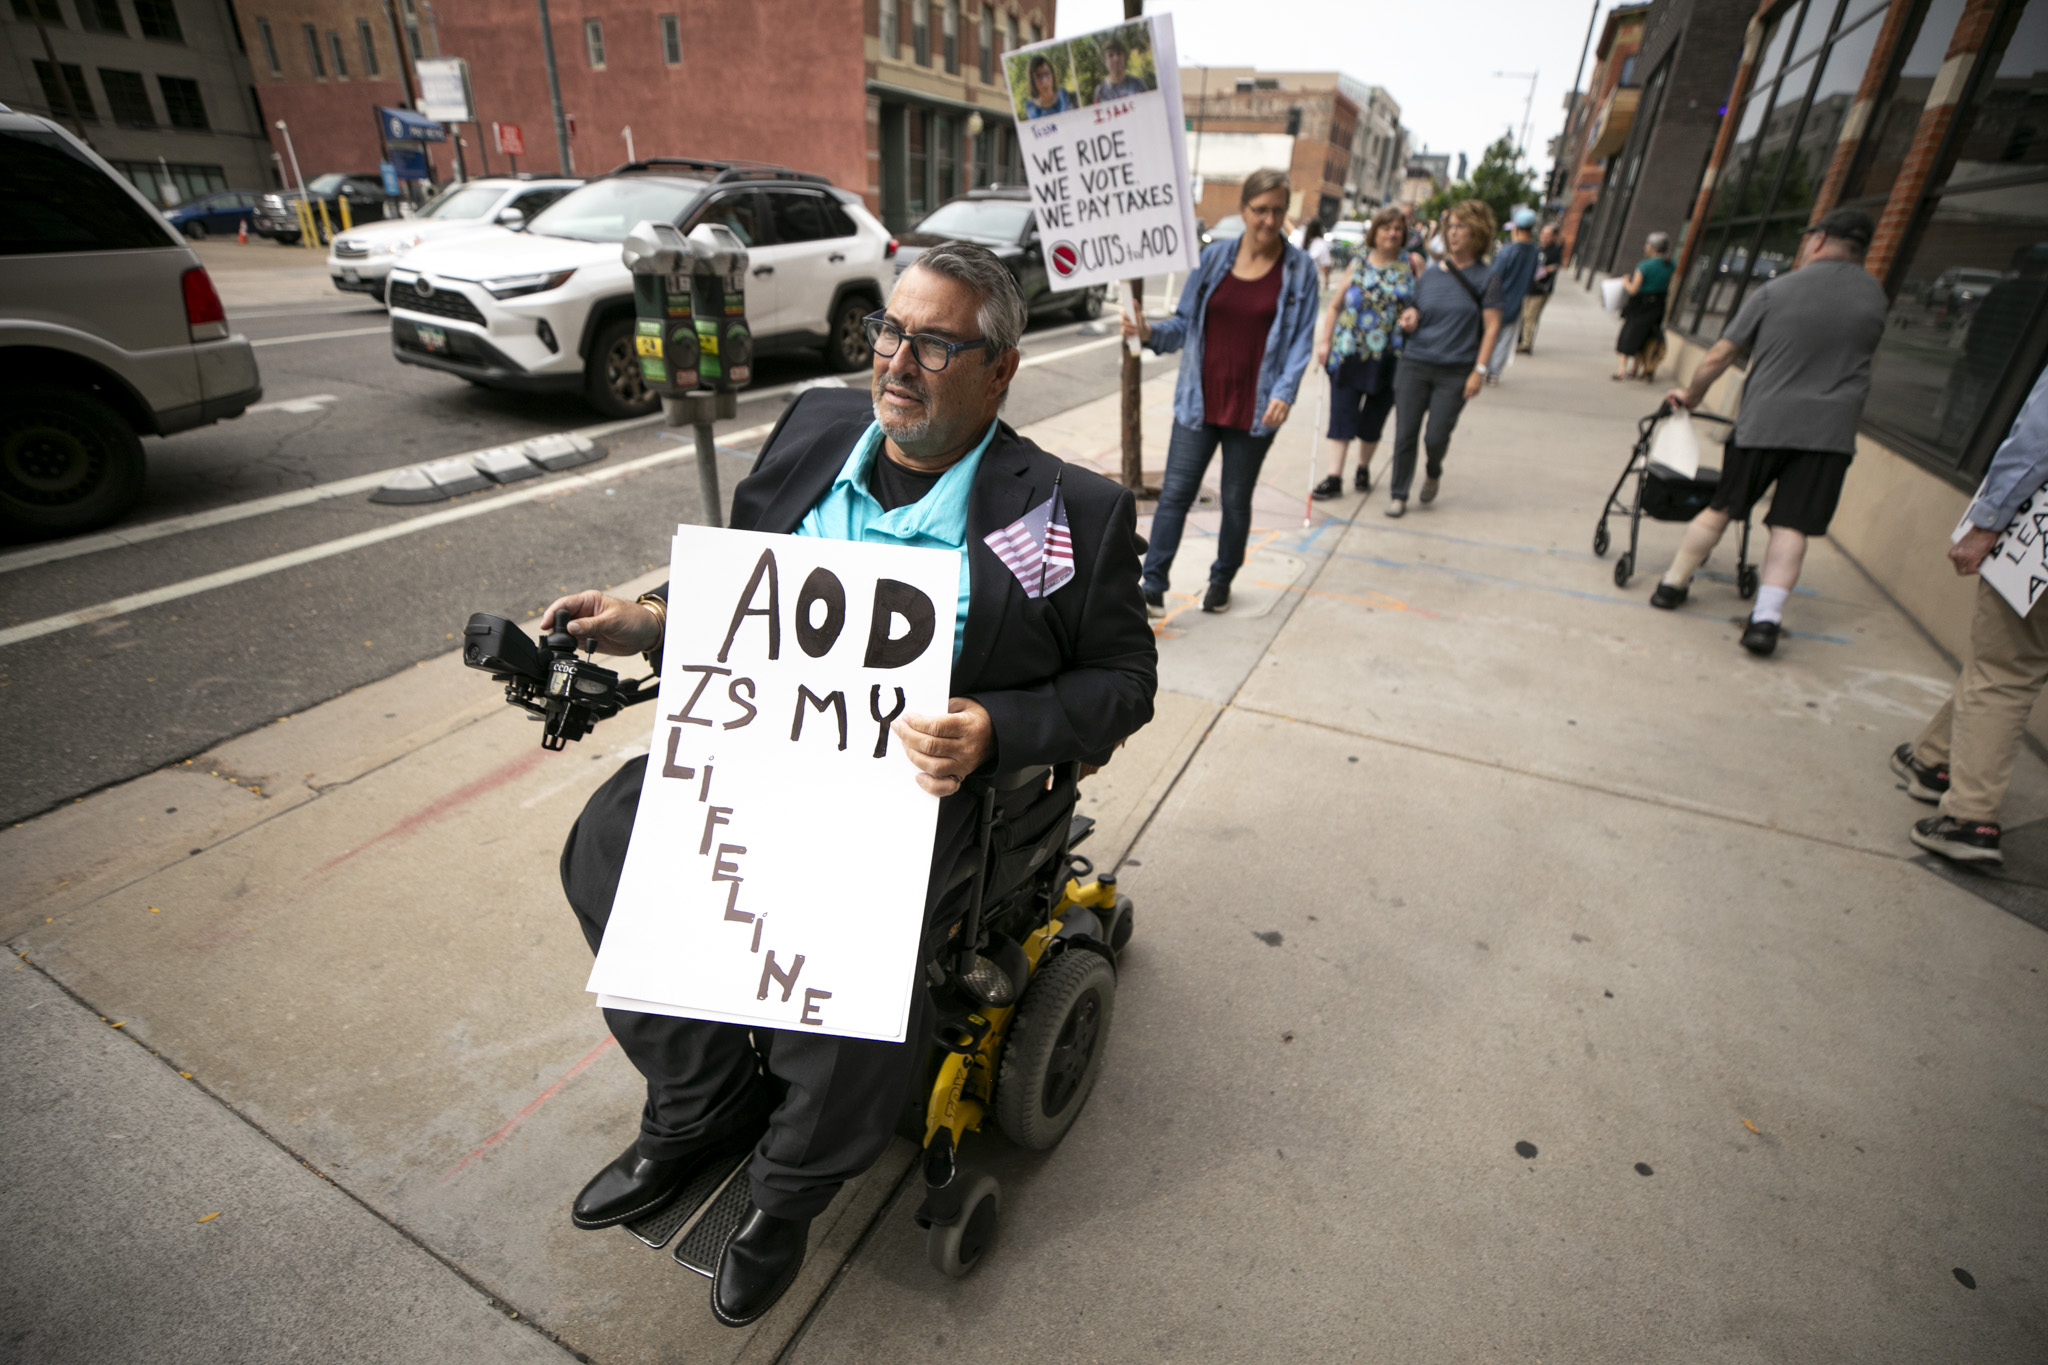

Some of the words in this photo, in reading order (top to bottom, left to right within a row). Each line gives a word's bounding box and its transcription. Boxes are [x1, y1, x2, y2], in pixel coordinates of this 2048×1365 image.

[1033, 145, 1067, 175] WE
[1035, 176, 1071, 204] WE
[1041, 202, 1074, 229] WE
[1078, 194, 1111, 222] PAY
[1081, 234, 1125, 271] CUTS
[1141, 224, 1178, 258] AOD
[2006, 502, 2048, 565] LEA
[717, 547, 936, 669] AOD
[667, 664, 757, 731] IS
[790, 683, 906, 758] MY
